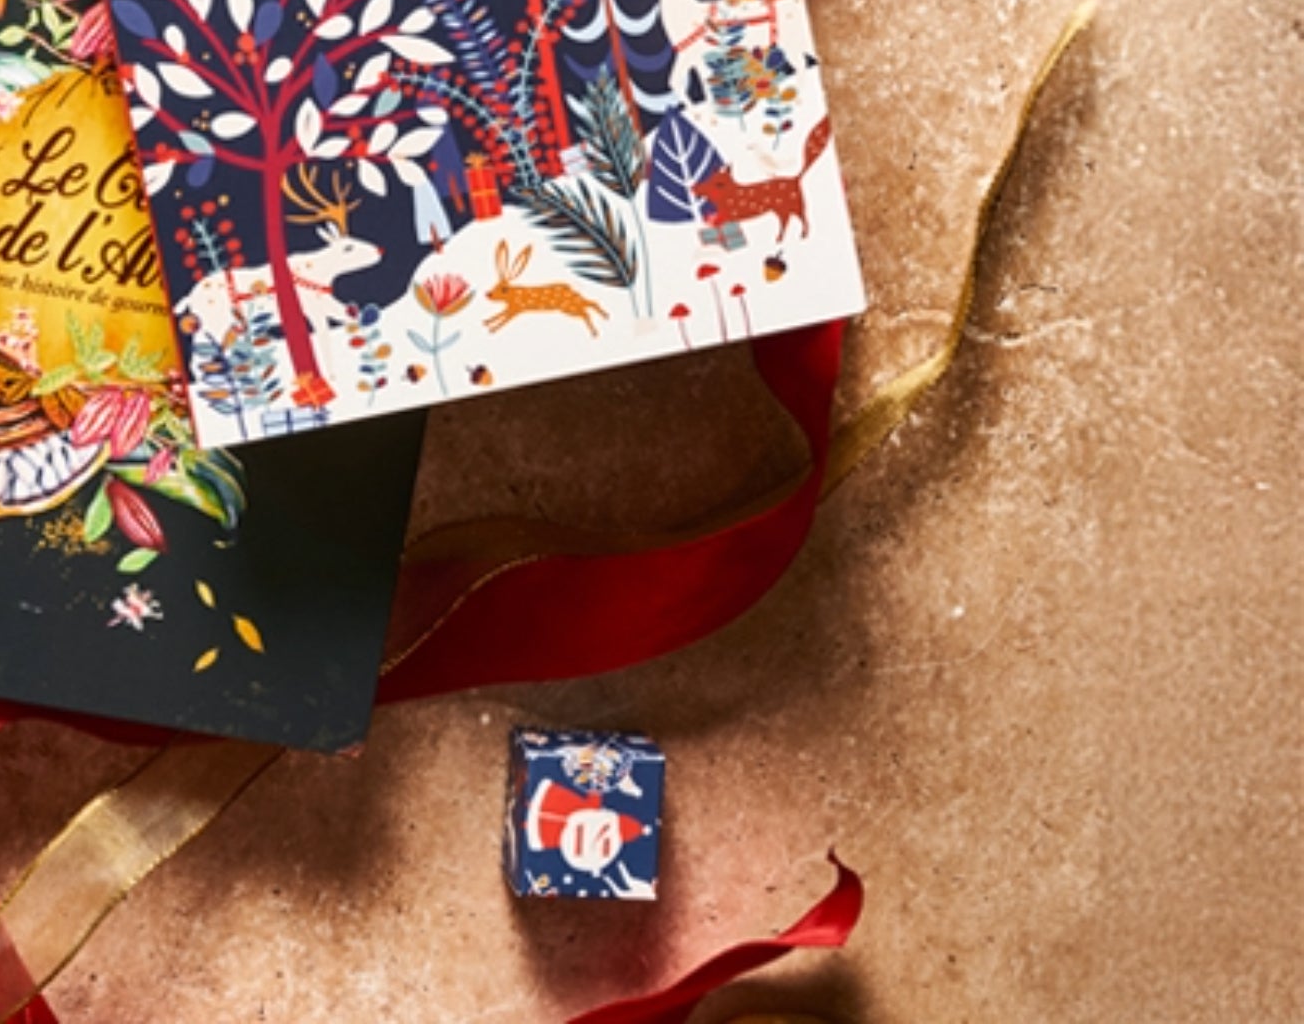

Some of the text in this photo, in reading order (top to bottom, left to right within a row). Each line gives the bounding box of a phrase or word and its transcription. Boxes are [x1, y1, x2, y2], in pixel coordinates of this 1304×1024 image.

[0, 125, 147, 213] Le C
[20, 272, 86, 301] histoire
[87, 286, 110, 307] de
